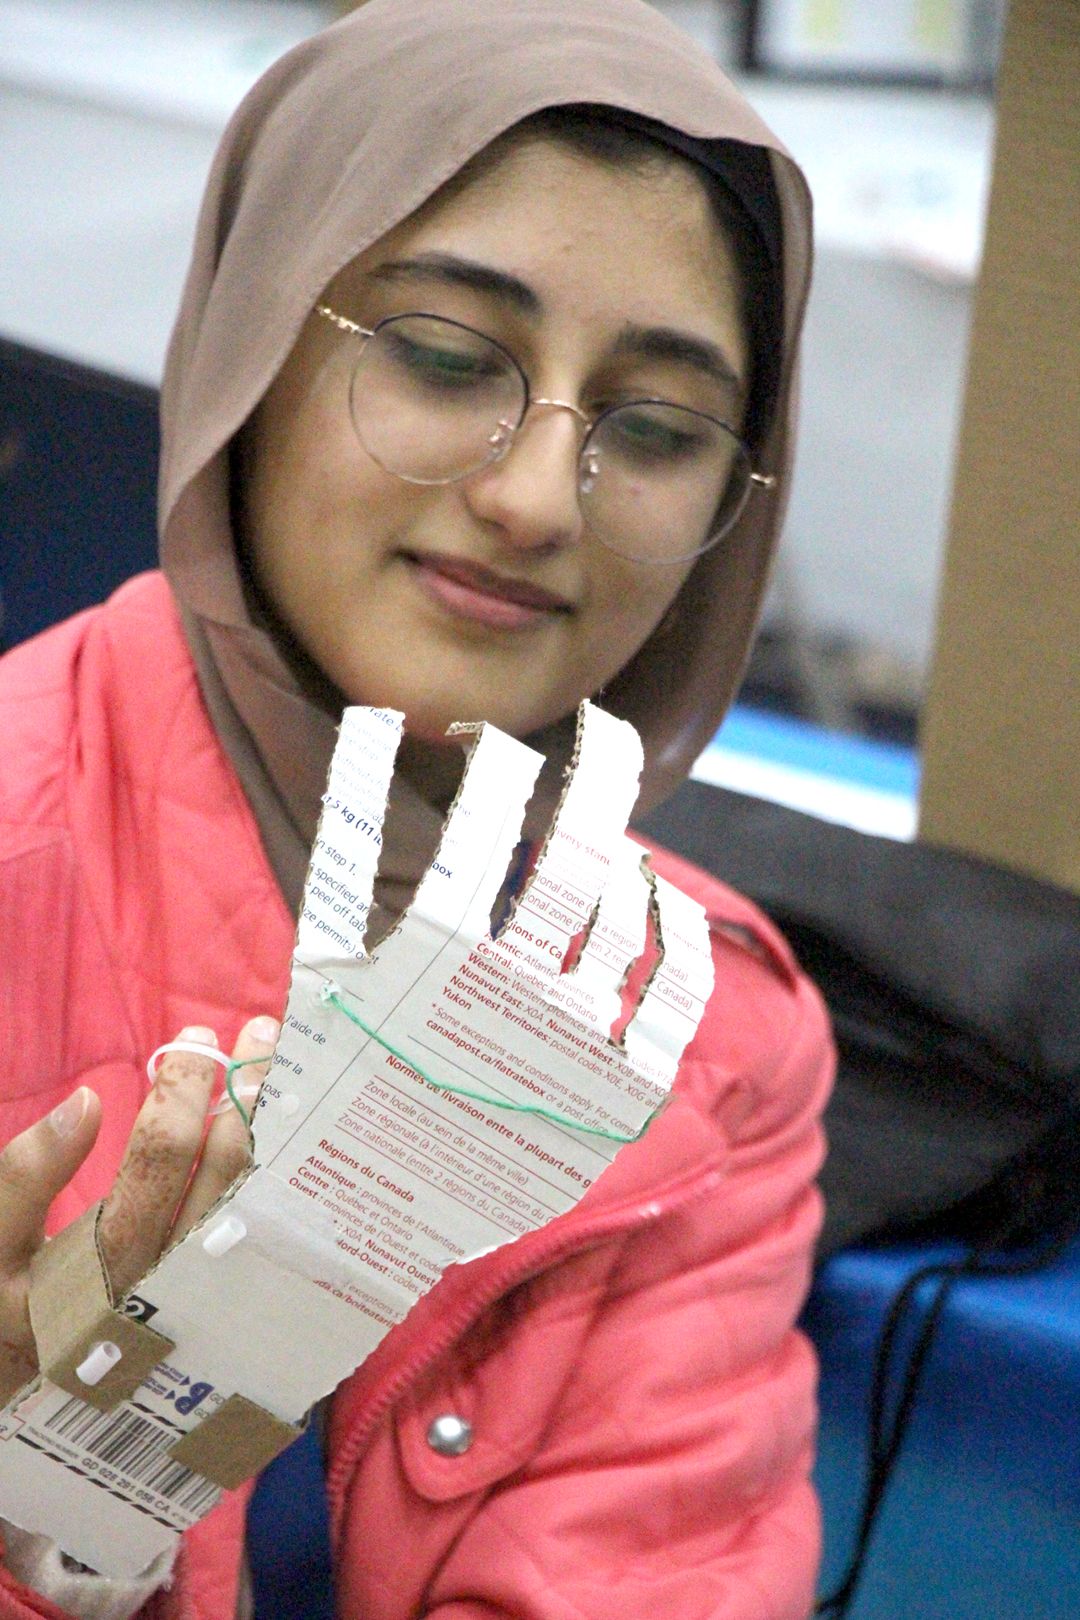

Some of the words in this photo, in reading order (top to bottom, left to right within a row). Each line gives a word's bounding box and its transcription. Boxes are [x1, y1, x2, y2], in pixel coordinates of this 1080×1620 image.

[337, 805, 358, 825] kg
[353, 816, 376, 839] (11
[322, 844, 350, 869] step
[346, 861, 361, 877] 1.
[308, 884, 334, 908] peel
[330, 900, 352, 921] off
[311, 866, 359, 906] specified
[560, 888, 587, 910] zone
[313, 917, 358, 955] permits)
[547, 906, 574, 927] zone
[533, 935, 552, 952] of
[606, 927, 639, 954] region
[475, 941, 516, 971] Central:
[511, 964, 550, 993] Quebec
[546, 985, 566, 1003] and
[563, 996, 600, 1023] Ontario
[521, 952, 559, 980] Atlantic
[440, 985, 474, 1011] Yukon
[465, 951, 512, 986] Western:
[508, 978, 550, 1009] Western
[545, 1002, 587, 1033] provinces
[585, 1026, 607, 1045] and
[653, 979, 695, 1012] Canada)
[311, 1030, 328, 1047] de
[447, 974, 502, 1013] Northwest
[499, 1005, 553, 1044] Territories:
[547, 1036, 580, 1063] postal
[575, 1053, 605, 1077] codes
[456, 962, 503, 997] Nunavut
[499, 989, 526, 1011] East:
[544, 1017, 590, 1051] Nunavut
[586, 1043, 617, 1068] West:
[632, 1072, 653, 1090] and
[291, 1062, 305, 1077] la
[423, 1016, 548, 1099] canadapost.ca/flatratebox
[544, 1091, 558, 1104] or
[562, 1102, 586, 1123] post
[433, 1005, 461, 1029] Some
[457, 1021, 509, 1060] exceptions
[506, 1050, 527, 1069] and
[524, 1062, 571, 1096] conditions
[567, 1088, 597, 1114] apply.
[593, 1104, 612, 1121] For
[260, 1082, 283, 1102] pas
[362, 1079, 391, 1102] Zone
[387, 1094, 418, 1119] locale
[414, 1110, 435, 1130] (au
[432, 1121, 454, 1141] sein
[451, 1133, 468, 1149] de
[465, 1141, 478, 1155] la
[474, 1147, 507, 1173] même
[503, 1165, 530, 1188] ville)
[383, 1053, 428, 1086] Normes
[439, 1088, 487, 1123] livraison
[484, 1116, 515, 1141] entre
[512, 1132, 528, 1148] la
[522, 1139, 566, 1173] plupart
[562, 1163, 585, 1183] des
[315, 1137, 362, 1172] Régions
[359, 1163, 377, 1180] du
[374, 1173, 416, 1205] Canada
[336, 1111, 365, 1135] Zone
[361, 1126, 408, 1161] nationale
[404, 1153, 436, 1179] (entre
[432, 1170, 444, 1183] 2
[439, 1174, 479, 1206] régions
[475, 1196, 492, 1212] du
[488, 1204, 531, 1237] Canada)
[349, 1095, 378, 1118] Zone
[373, 1110, 421, 1146] régionale
[417, 1136, 432, 1152] (à
[472, 1169, 503, 1195] d'une
[498, 1186, 533, 1215] région
[529, 1206, 546, 1222] du
[286, 1175, 319, 1200] Ouest
[320, 1196, 365, 1229] provinces
[362, 1220, 379, 1236] de
[375, 1228, 410, 1256] l'Ouest
[407, 1248, 420, 1261] et
[295, 1164, 331, 1192] Centre
[332, 1186, 371, 1217] Québec
[368, 1208, 381, 1222] et
[378, 1214, 415, 1242] Ontario
[302, 1153, 358, 1194] Atlantique
[359, 1188, 404, 1221] provinces
[401, 1211, 418, 1228] de
[413, 1219, 468, 1259] l'Atlantique
[363, 1237, 408, 1270] Nunavut
[404, 1263, 437, 1288] Ouest
[346, 1282, 395, 1317] exceptions
[391, 1271, 420, 1295] codes
[80, 1455, 100, 1473] GD
[153, 1498, 171, 1515] CA
